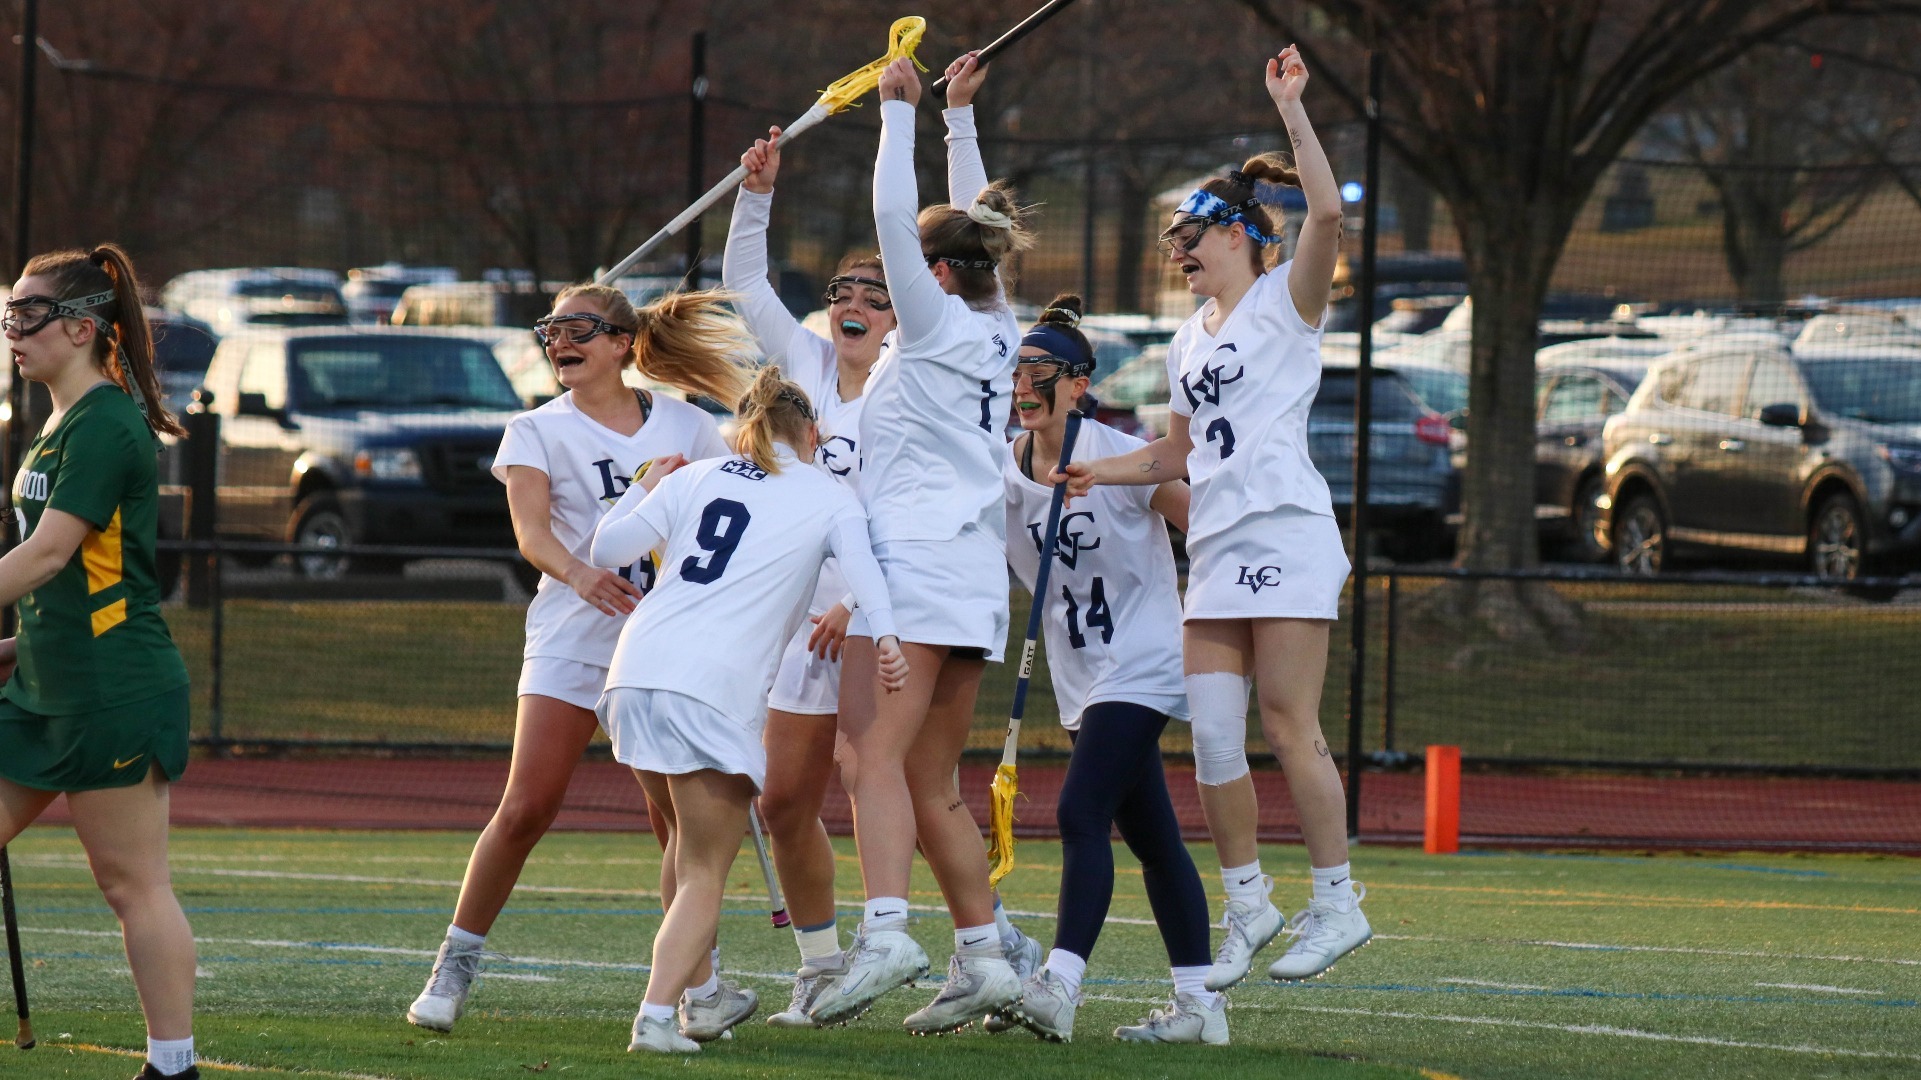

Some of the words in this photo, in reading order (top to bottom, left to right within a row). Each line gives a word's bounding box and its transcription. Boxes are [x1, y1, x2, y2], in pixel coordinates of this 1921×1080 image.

[1220, 204, 1242, 218] STX
[86, 292, 109, 305] STX
[722, 461, 767, 481] MAC
[680, 498, 751, 585] 9
[1235, 566, 1282, 594] LVC
[1062, 577, 1115, 650] 14
[1024, 646, 1035, 675] GAIT
